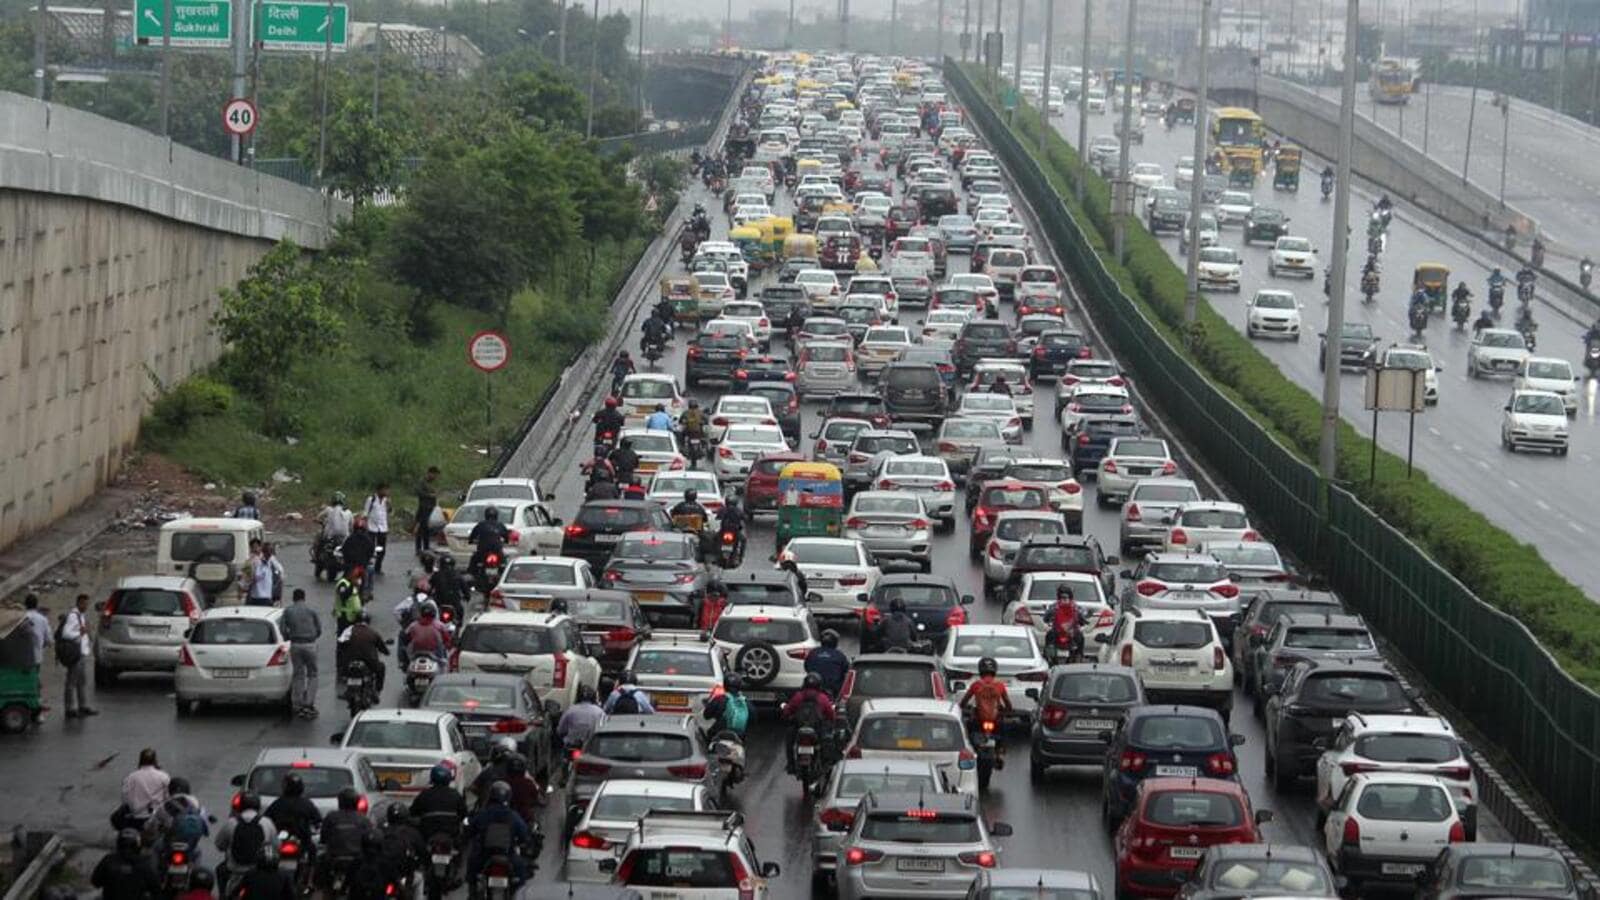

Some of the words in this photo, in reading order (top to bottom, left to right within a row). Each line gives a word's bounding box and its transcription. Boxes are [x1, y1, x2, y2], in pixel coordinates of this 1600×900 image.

[268, 5, 299, 20] दिल्ली
[174, 22, 220, 33] Sukhrali
[268, 25, 298, 36] Delhi
[229, 109, 251, 125] 40
